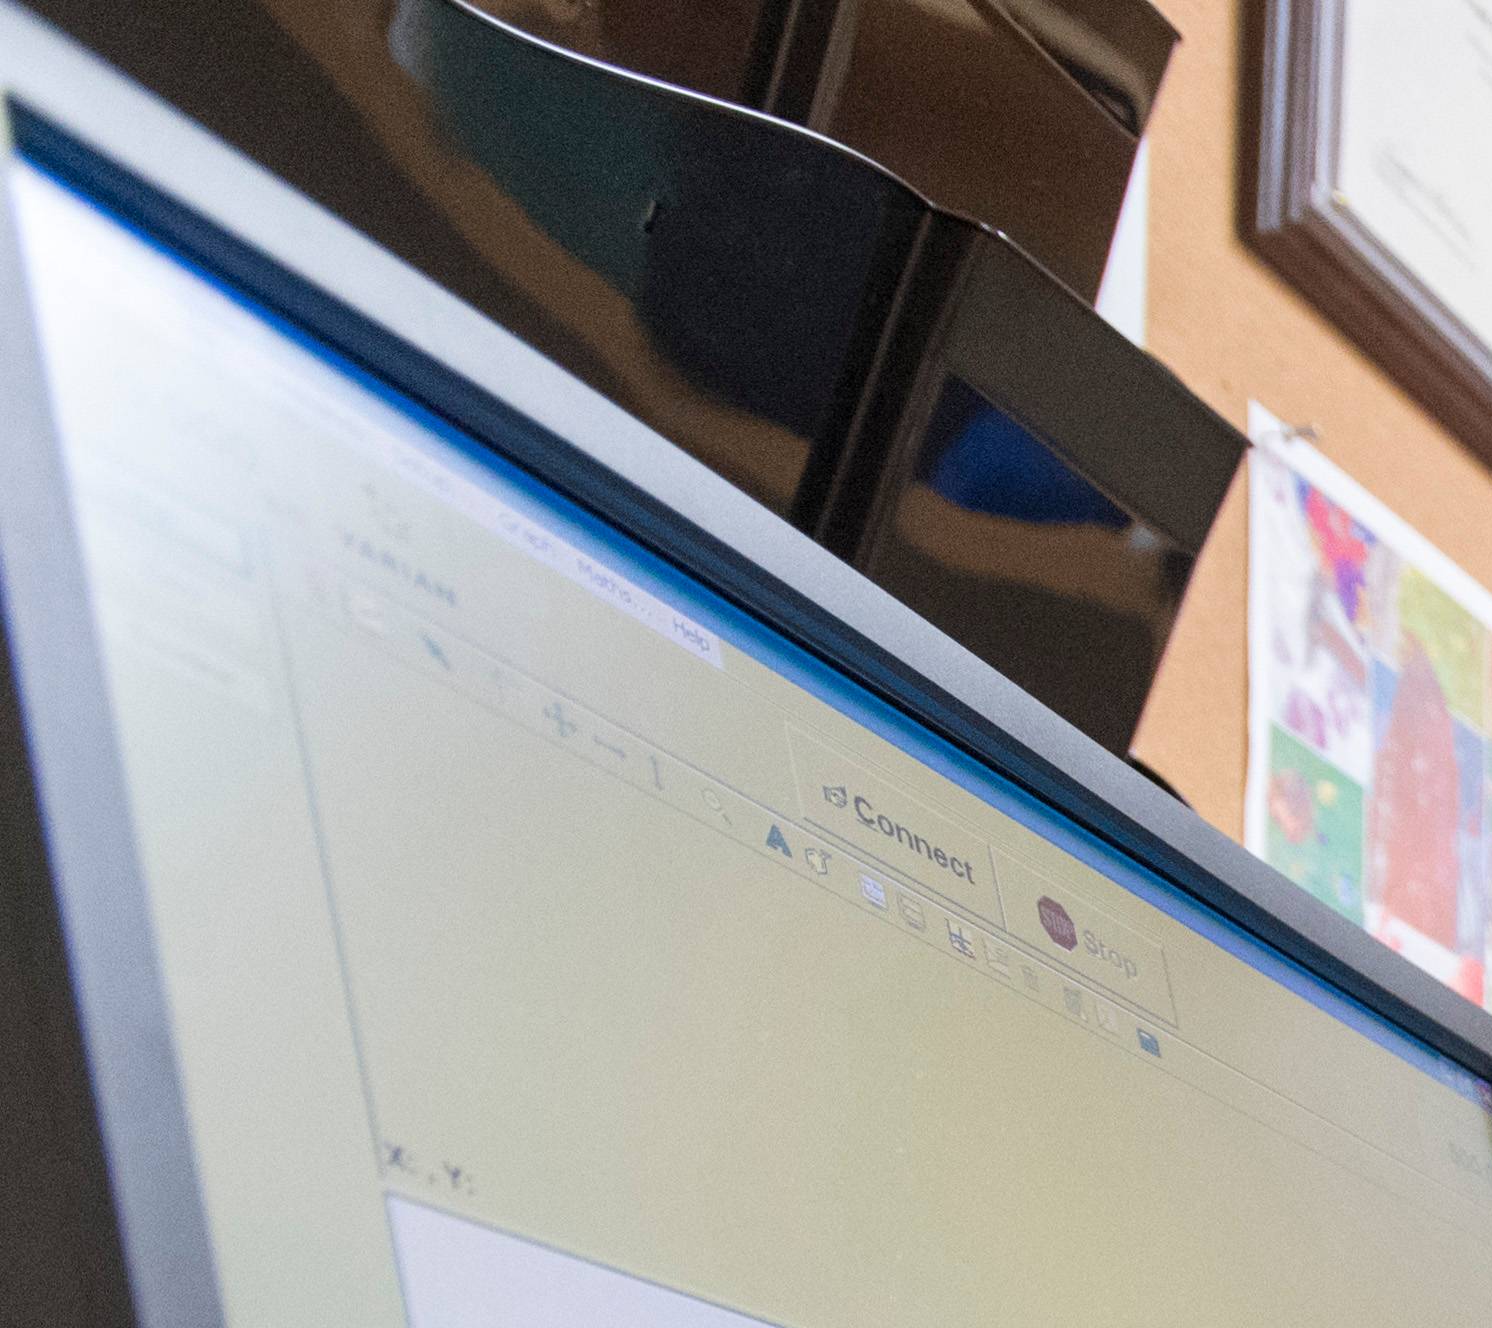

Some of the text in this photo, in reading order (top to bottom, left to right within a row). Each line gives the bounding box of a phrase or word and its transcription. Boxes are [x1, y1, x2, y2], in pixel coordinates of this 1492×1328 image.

[673, 619, 711, 653] Help
[854, 796, 976, 885] Connect
[1083, 930, 1138, 979] Stop
